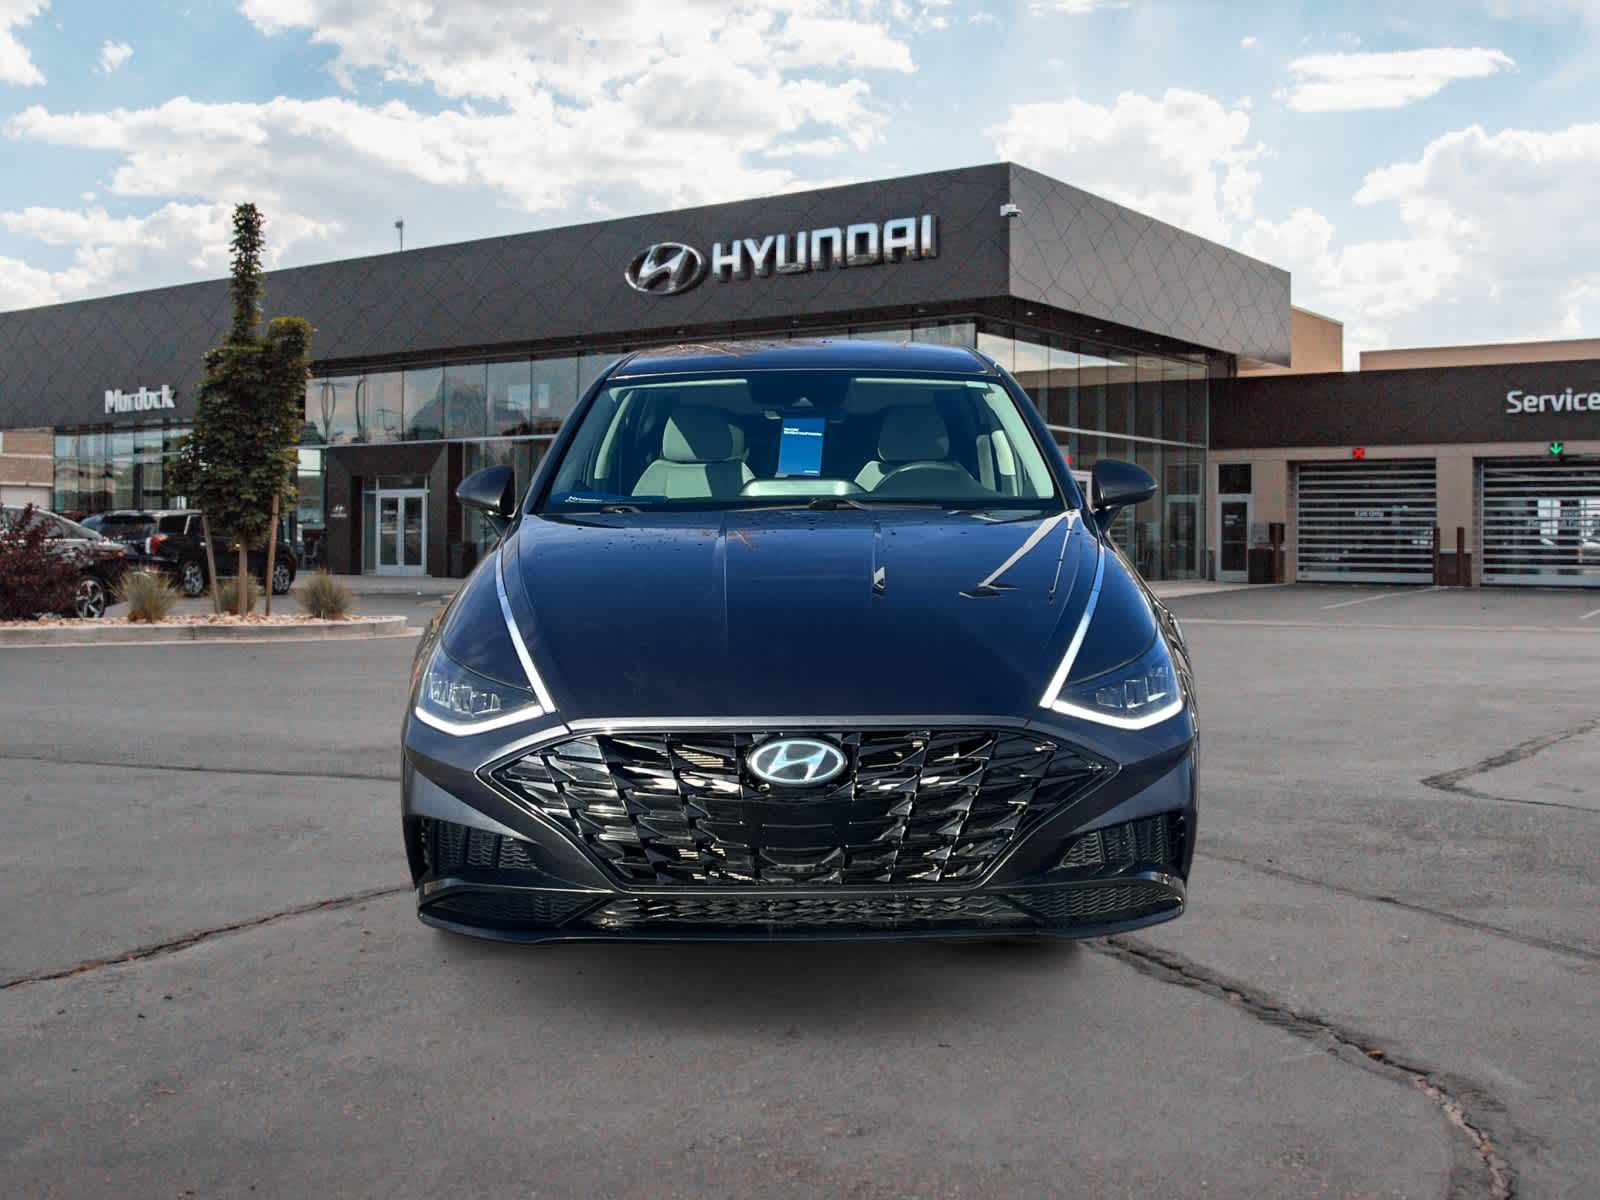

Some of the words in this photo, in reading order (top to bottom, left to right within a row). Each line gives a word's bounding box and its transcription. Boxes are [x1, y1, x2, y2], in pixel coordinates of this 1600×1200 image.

[712, 214, 938, 282] HYUNDAI
[104, 384, 176, 414] Murdock
[1505, 387, 1600, 414] Service
